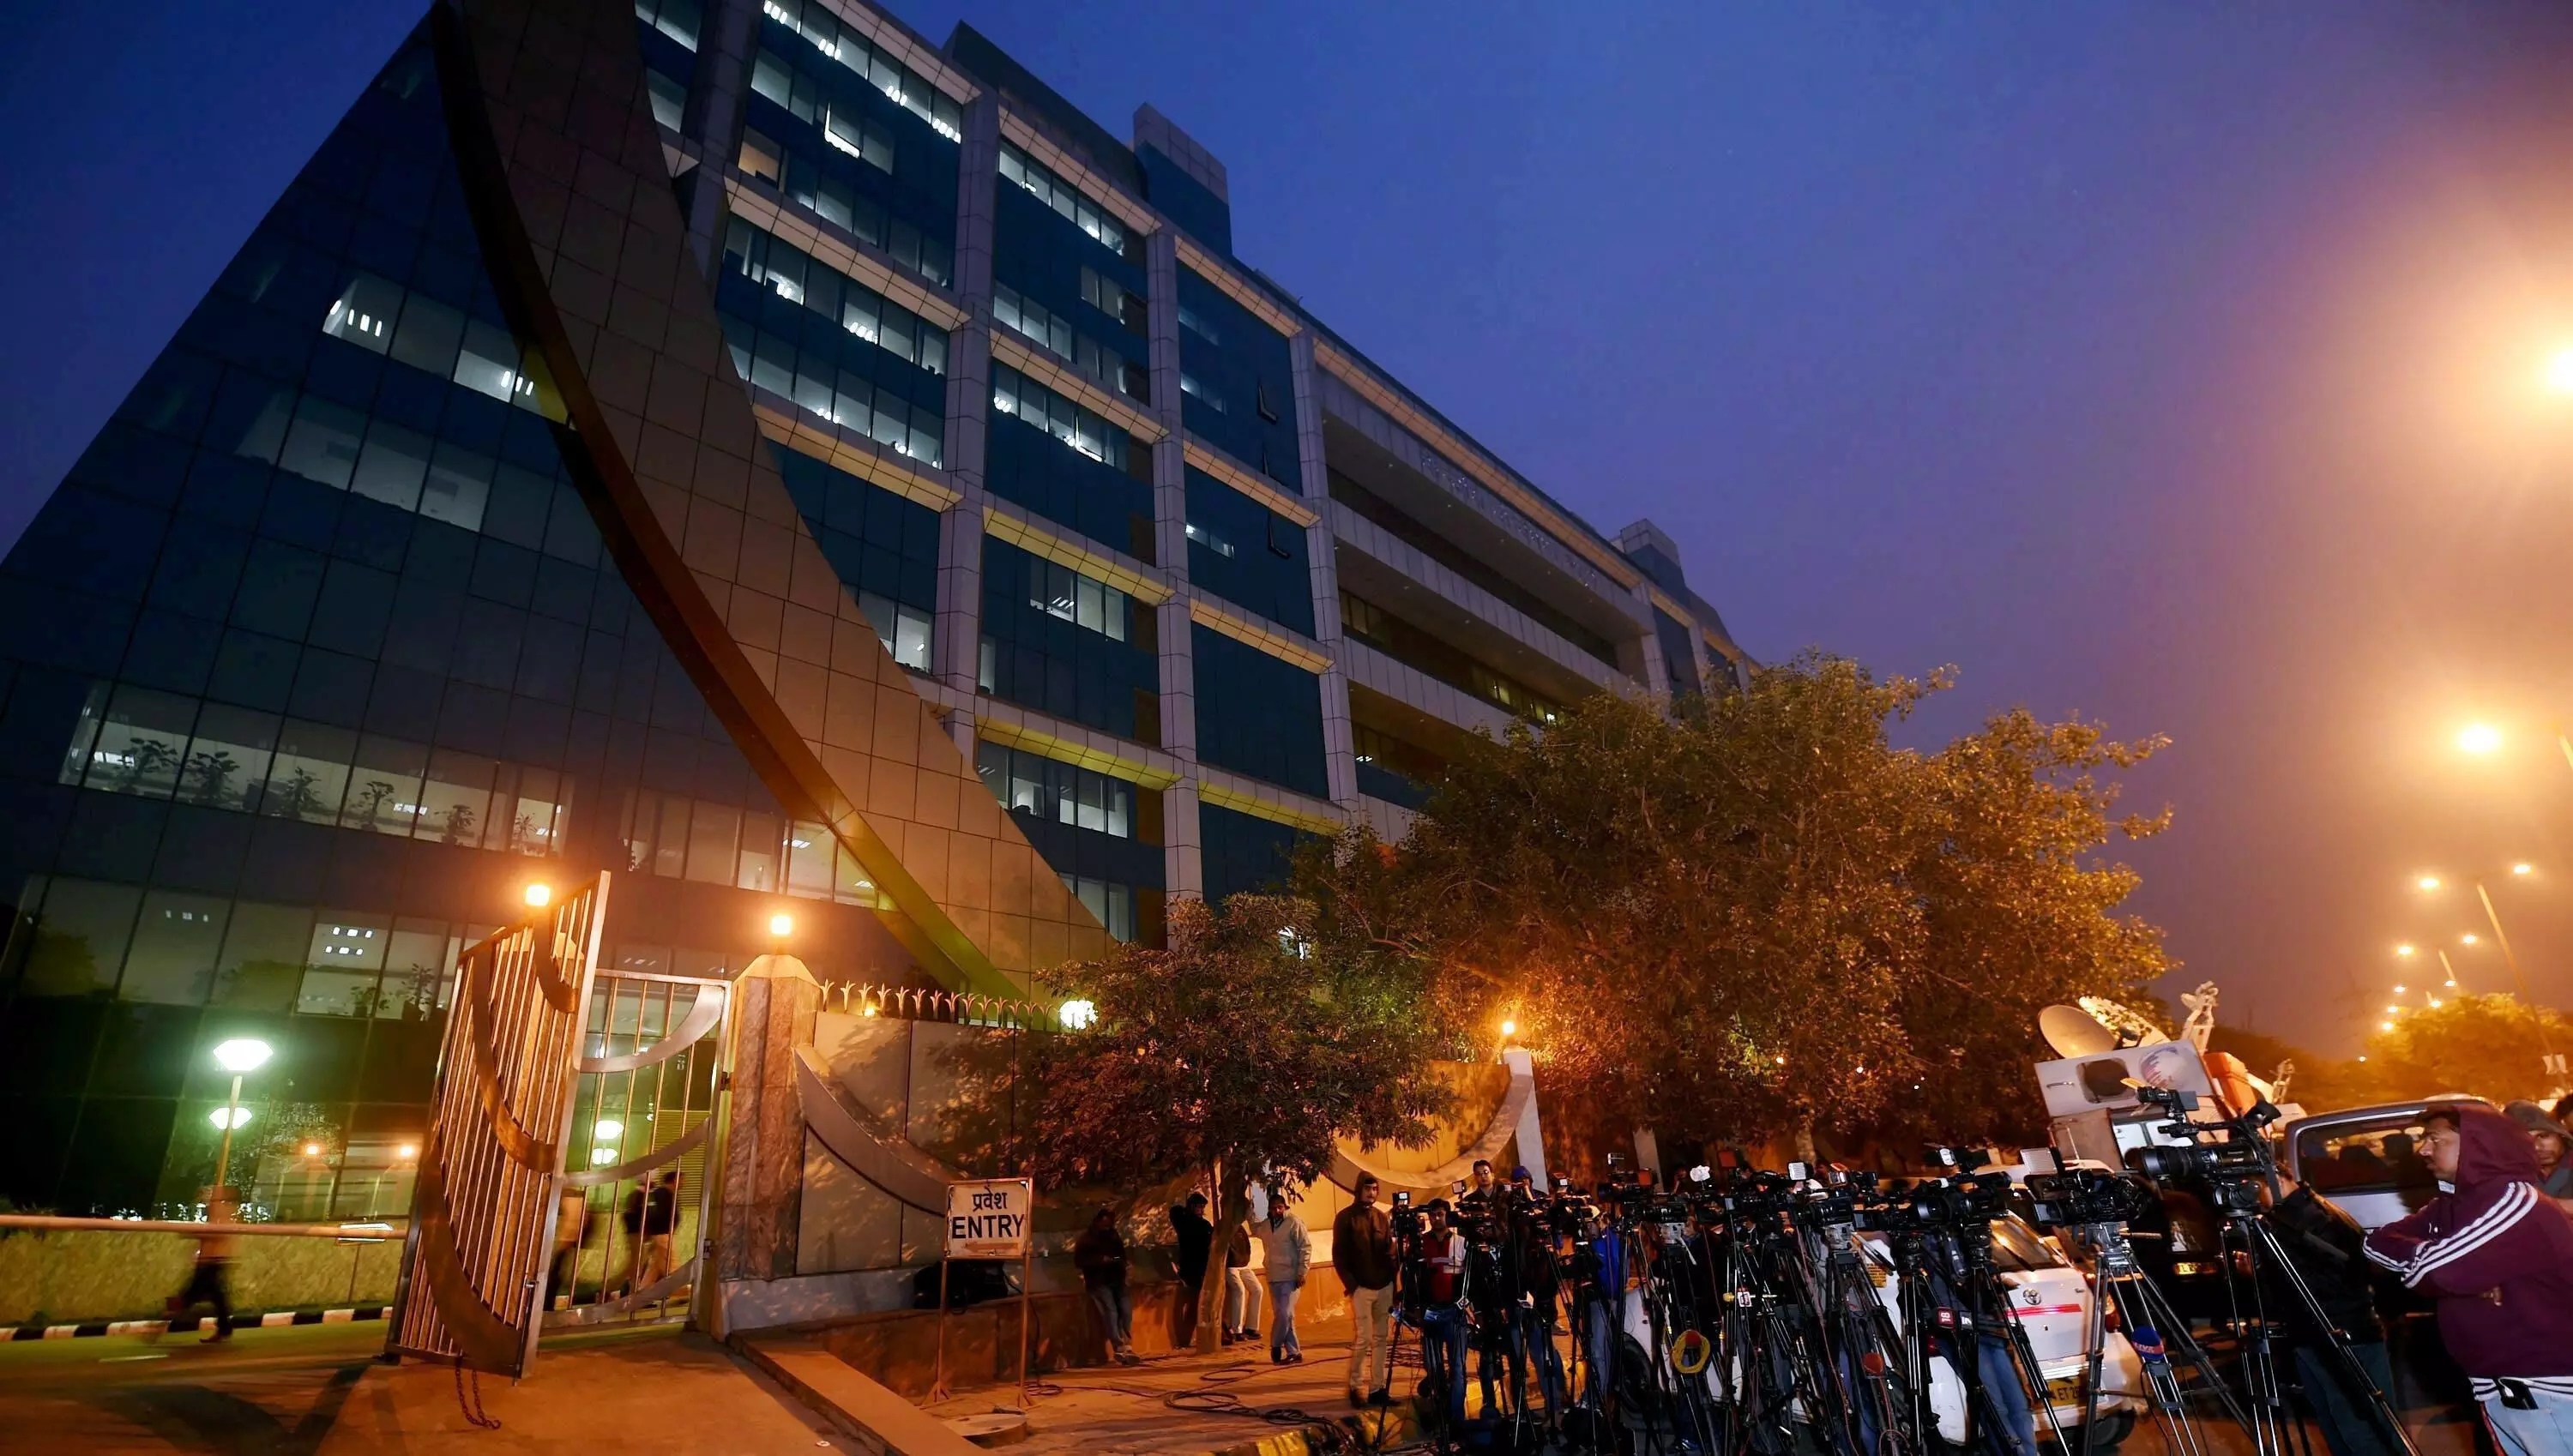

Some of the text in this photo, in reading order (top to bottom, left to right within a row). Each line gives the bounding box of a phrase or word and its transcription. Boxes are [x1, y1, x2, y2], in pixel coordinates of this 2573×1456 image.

[973, 1185, 1007, 1212] प्रवेश
[952, 1214, 1025, 1238] ENTRY
[1941, 1312, 1951, 1322] 18
